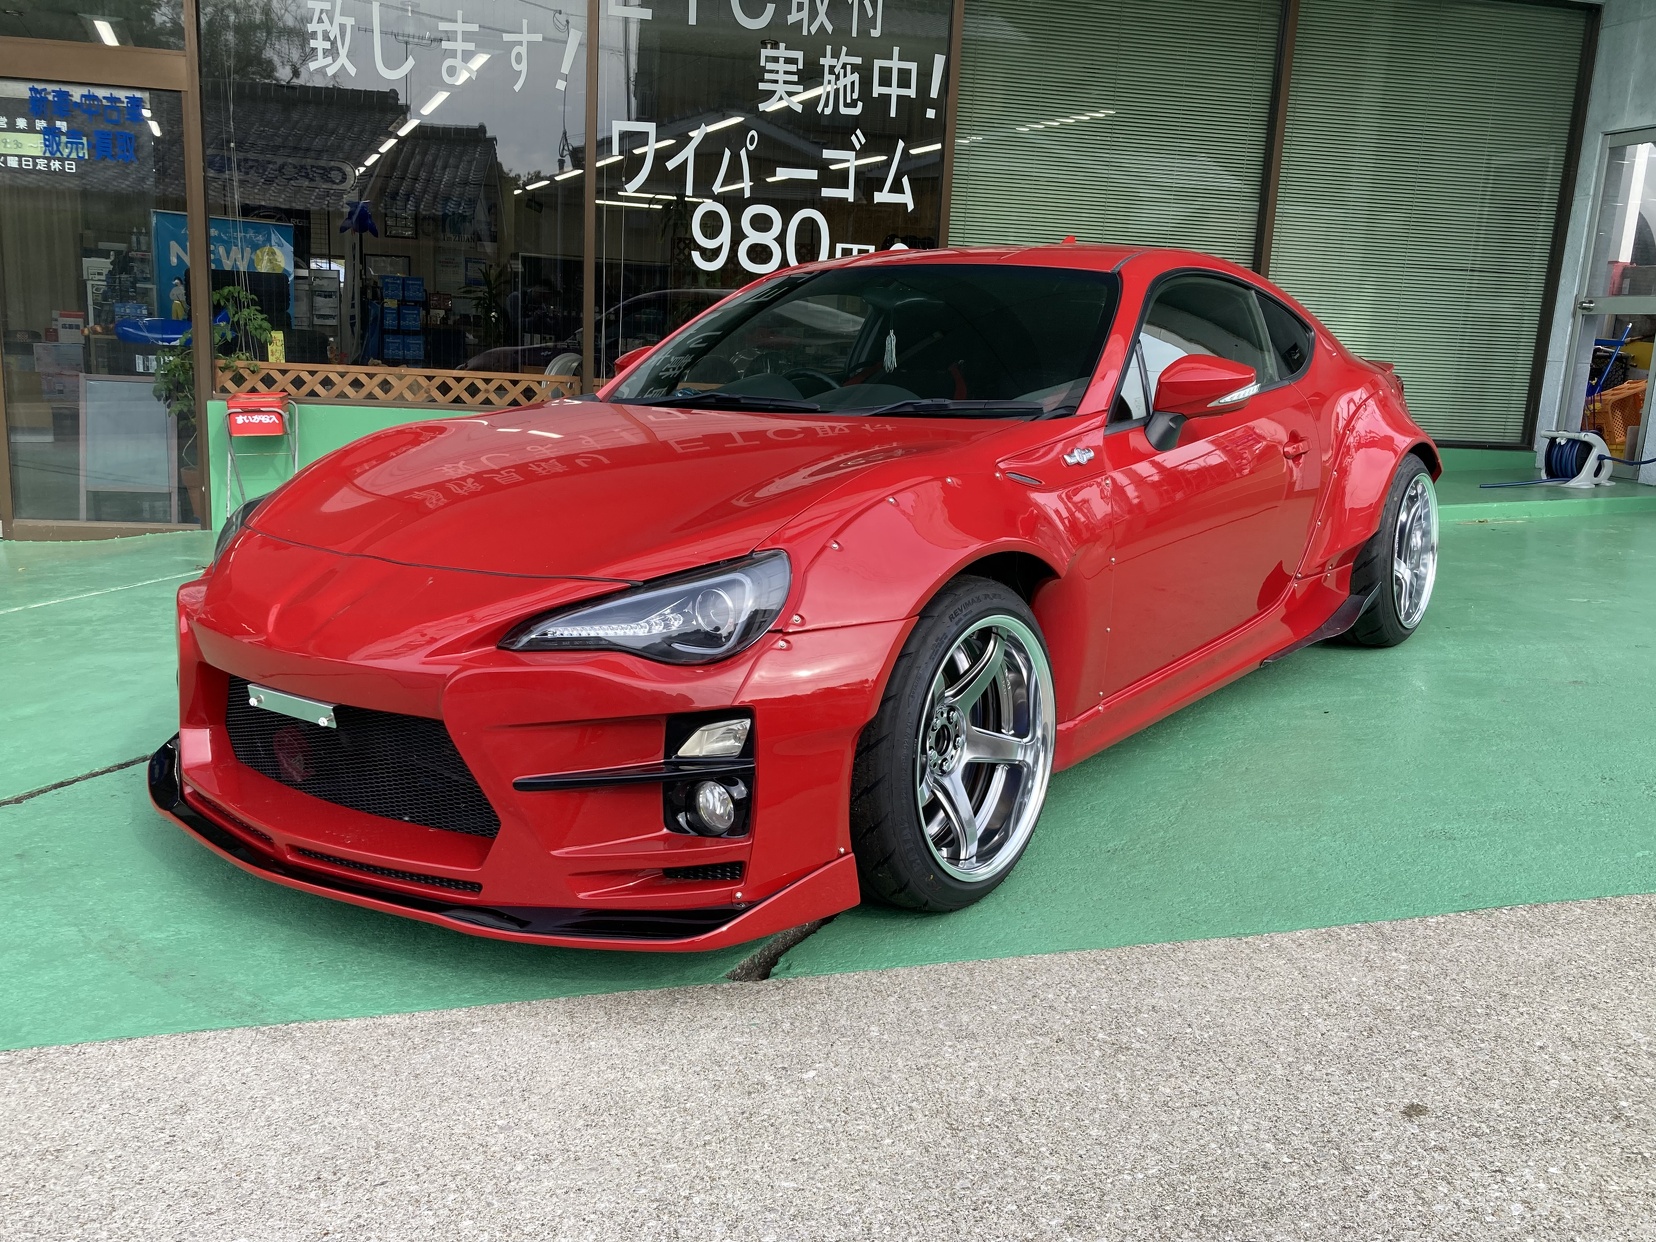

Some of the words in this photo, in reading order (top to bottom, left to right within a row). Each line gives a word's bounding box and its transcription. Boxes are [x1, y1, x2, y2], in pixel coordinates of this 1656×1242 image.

[307, 0, 583, 92] 致します!
[758, 42, 946, 119] 実施中!
[611, 120, 915, 212] ワイパーゴム
